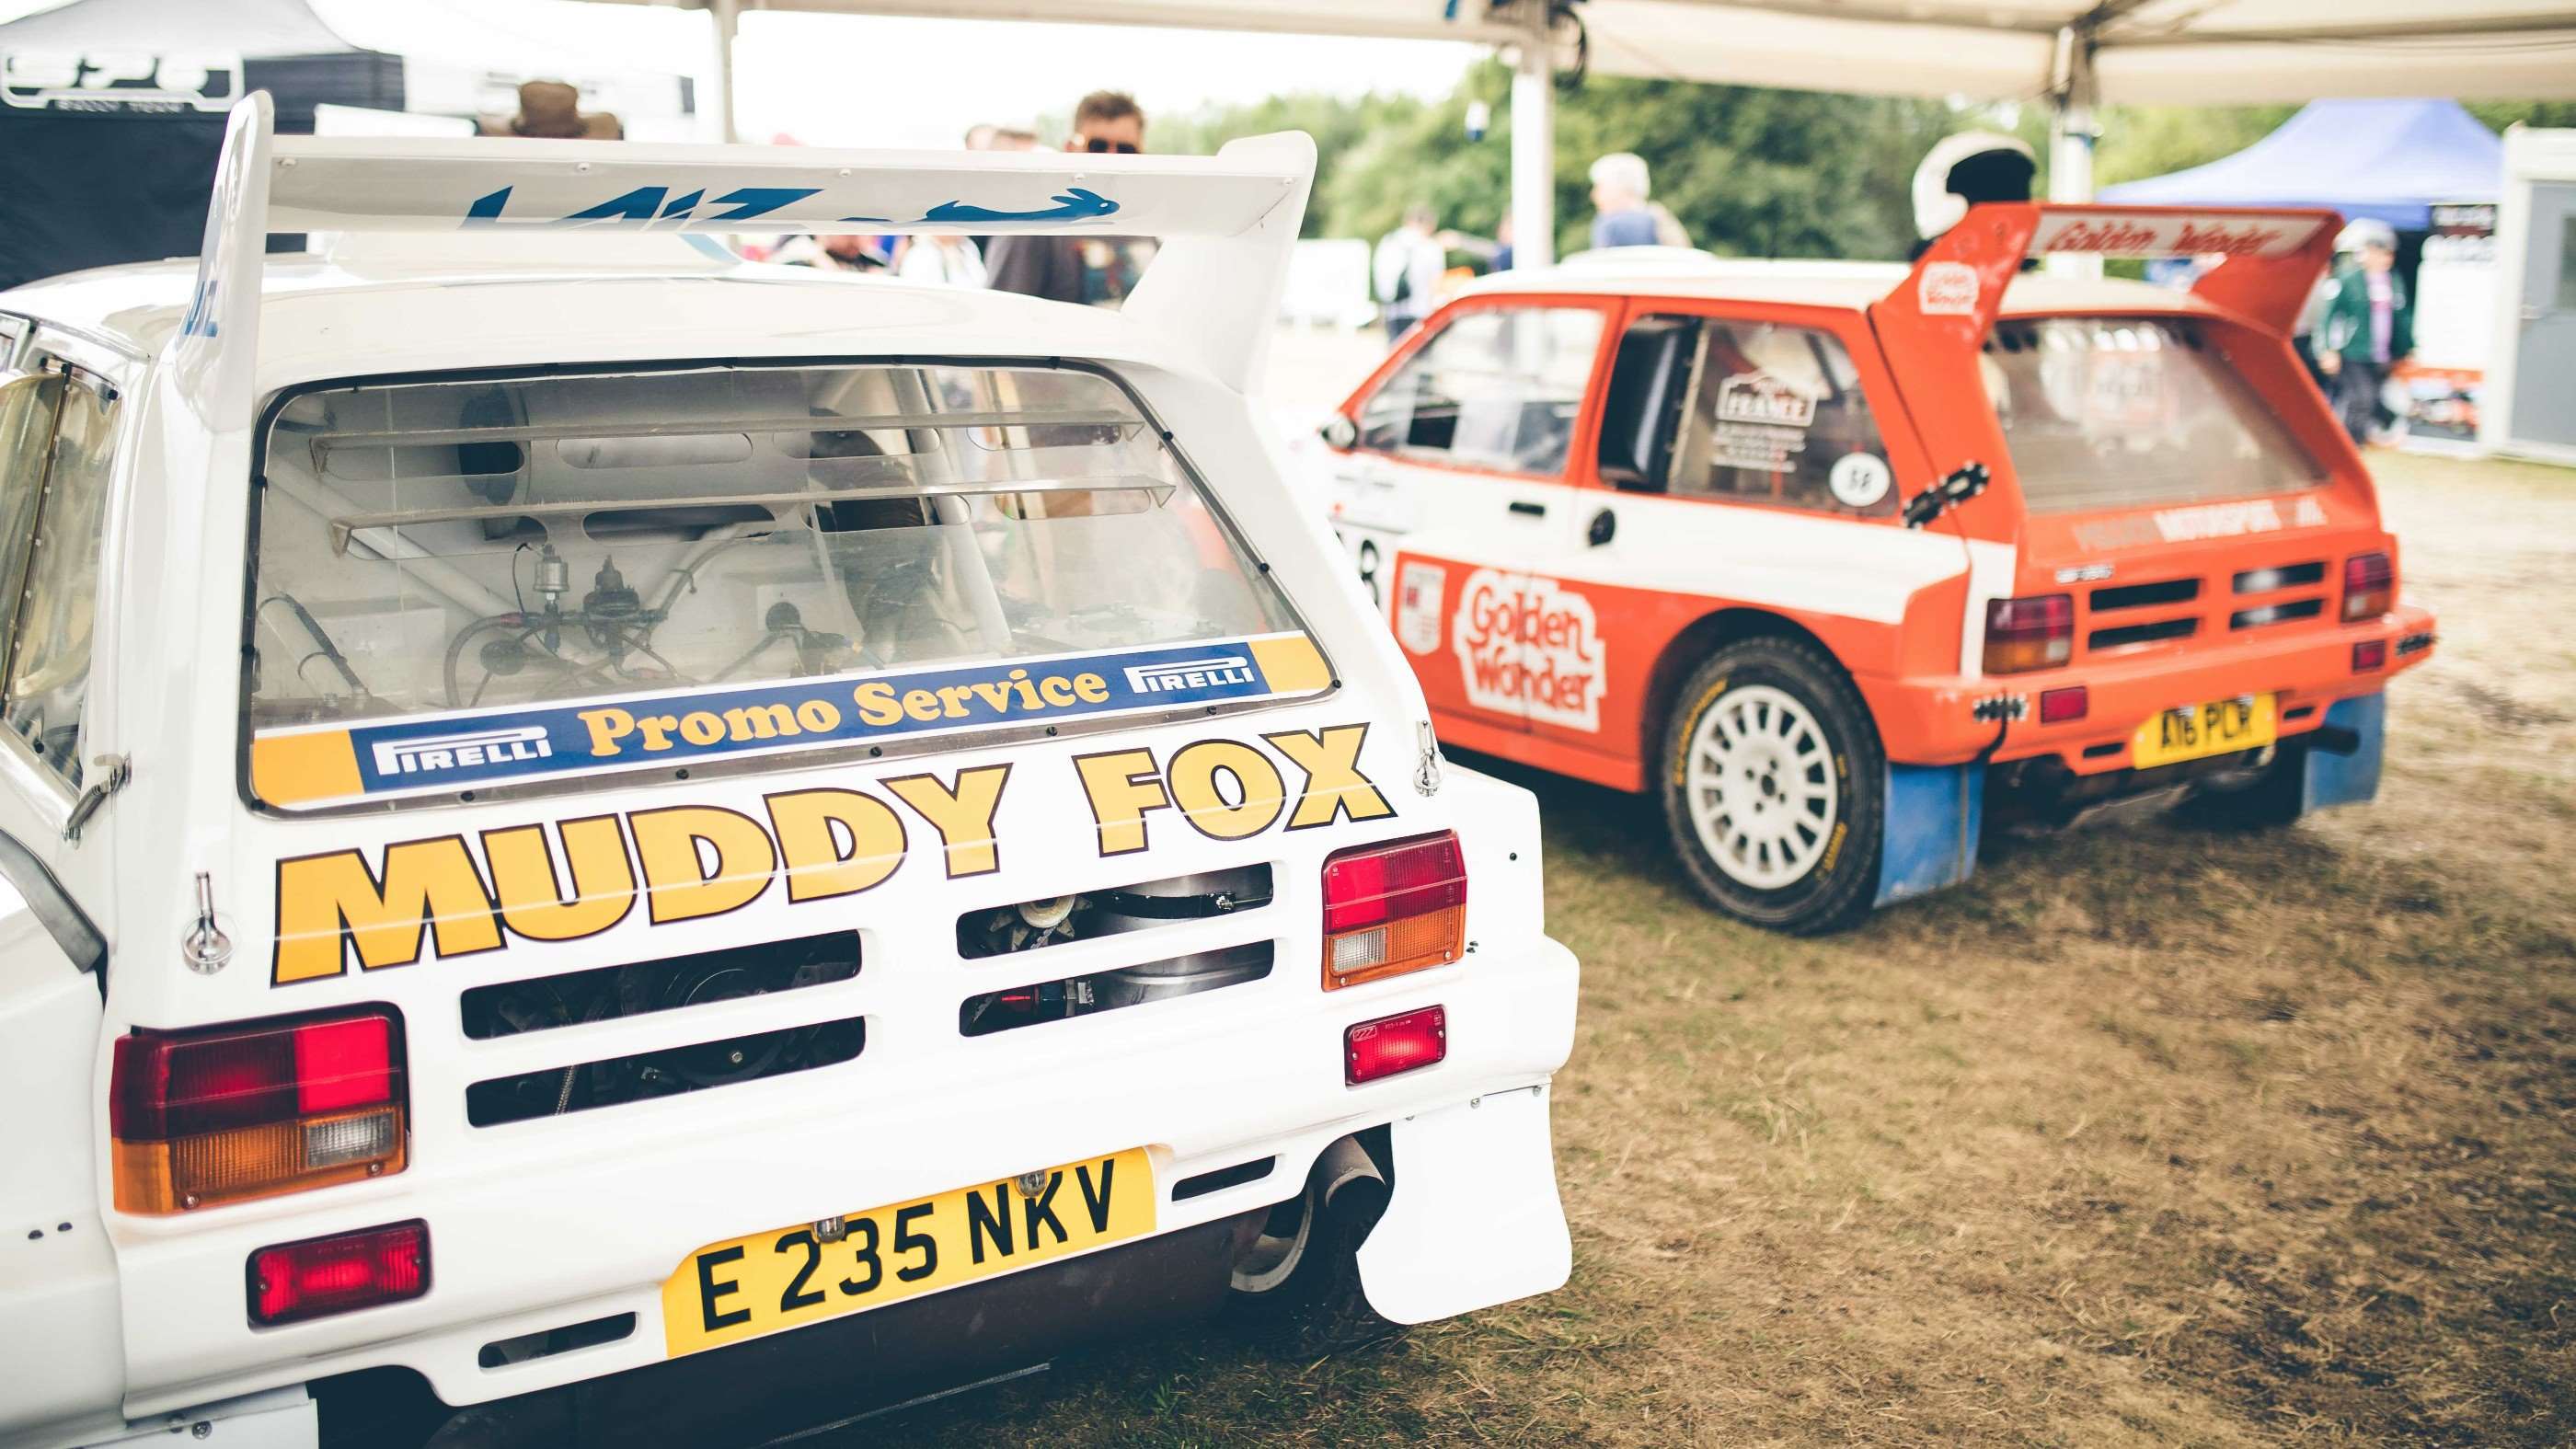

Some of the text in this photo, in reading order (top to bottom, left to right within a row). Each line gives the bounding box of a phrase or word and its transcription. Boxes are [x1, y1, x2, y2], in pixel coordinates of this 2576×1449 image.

[1465, 584, 1592, 663] Golden
[1469, 645, 1593, 714] Wonder
[372, 655, 1256, 776] PIRELLI Promo Service PIRELLI
[270, 722, 1398, 988] MUDDY FOX
[696, 1158, 1115, 1334] E 235 NKV
